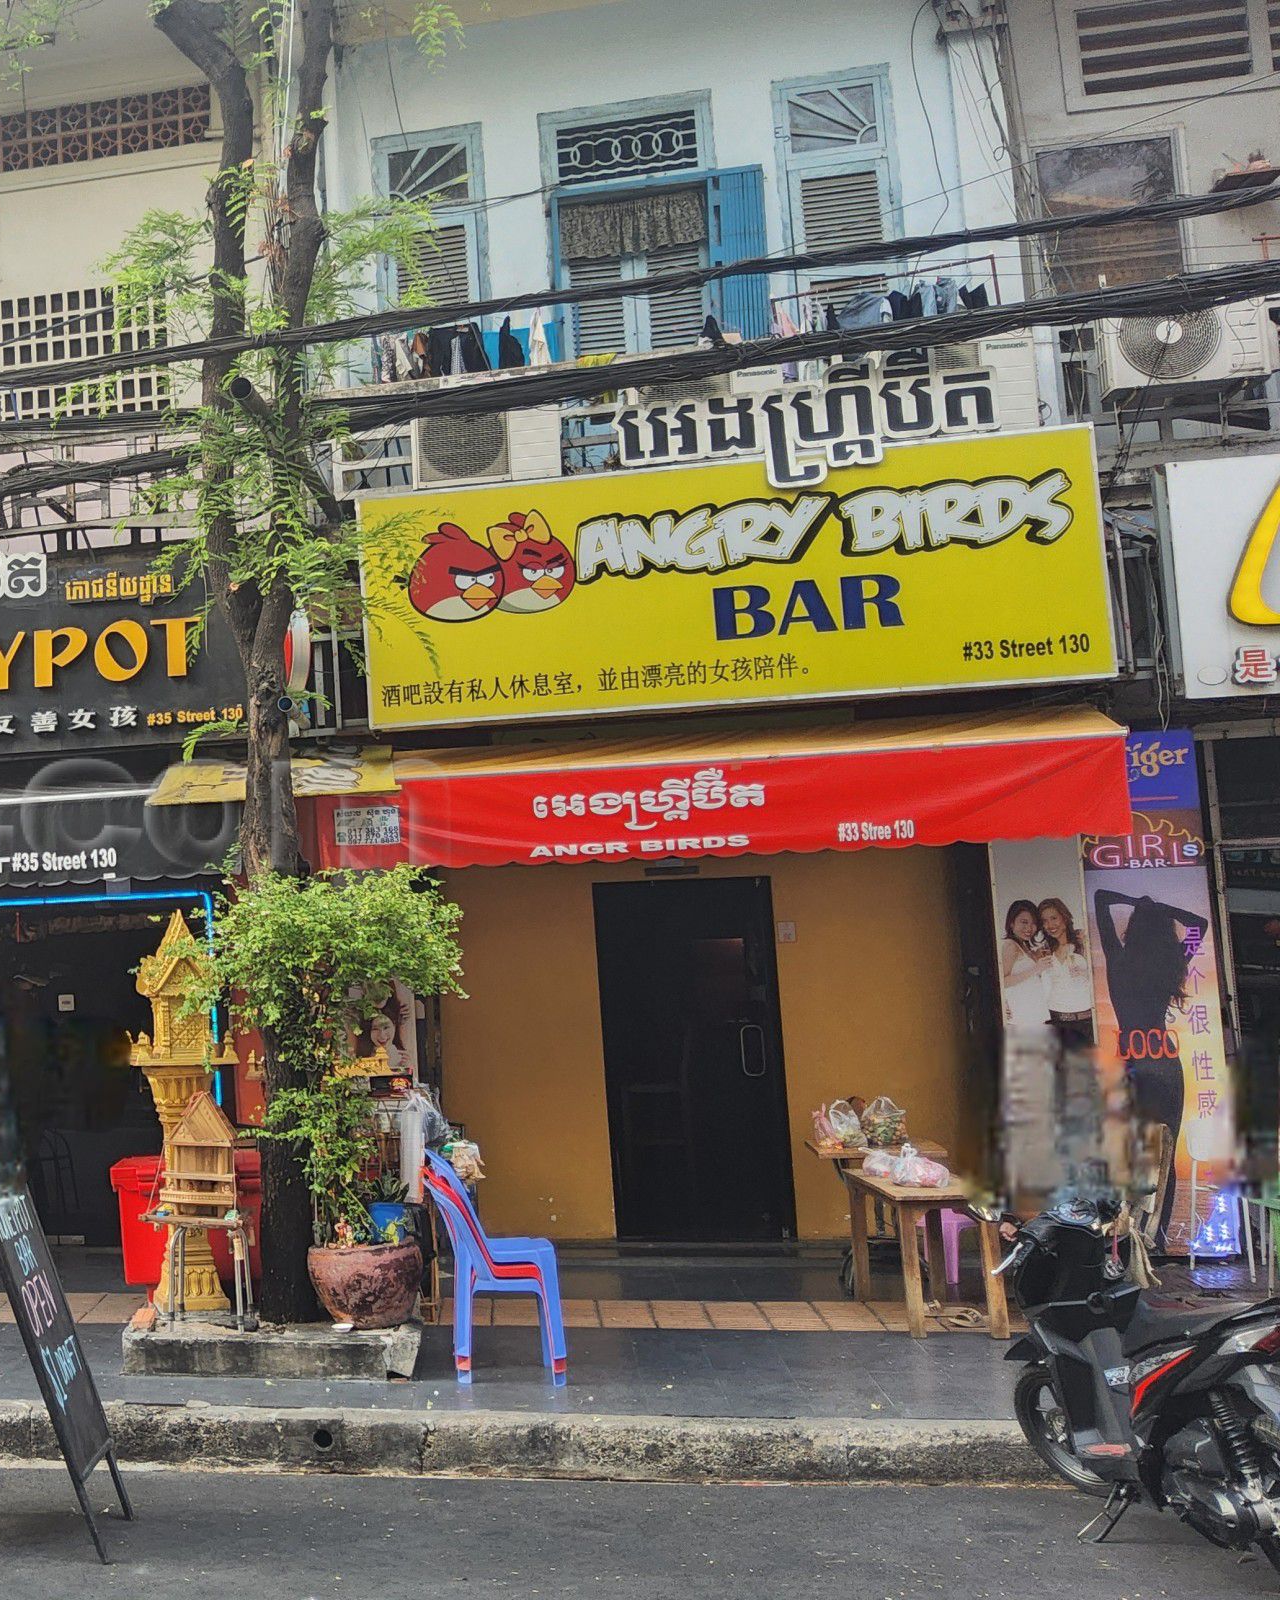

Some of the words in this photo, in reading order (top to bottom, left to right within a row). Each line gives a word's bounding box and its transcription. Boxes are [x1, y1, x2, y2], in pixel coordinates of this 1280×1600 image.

[986, 339, 1028, 350] Panasonic
[737, 367, 777, 378] Panasonic
[577, 496, 831, 581] ANGRY
[840, 472, 1071, 552] BIRDS
[712, 574, 905, 641] BAR
[962, 639, 994, 660] #33
[999, 636, 1054, 658] Street
[1059, 634, 1090, 654] 130
[147, 711, 173, 727] #35
[177, 709, 216, 724] Street
[221, 707, 244, 721] 130
[837, 821, 859, 842] #33
[861, 823, 891, 842] Stree
[894, 819, 915, 839] 130
[529, 841, 629, 858] ANGR
[641, 835, 750, 852] BIRDS
[12, 851, 39, 874] #35
[42, 850, 88, 872] Street
[90, 848, 117, 869] 130
[1113, 1029, 1180, 1061] LOCO
[14, 1235, 38, 1277] BAR
[21, 1269, 58, 1338] OPEN
